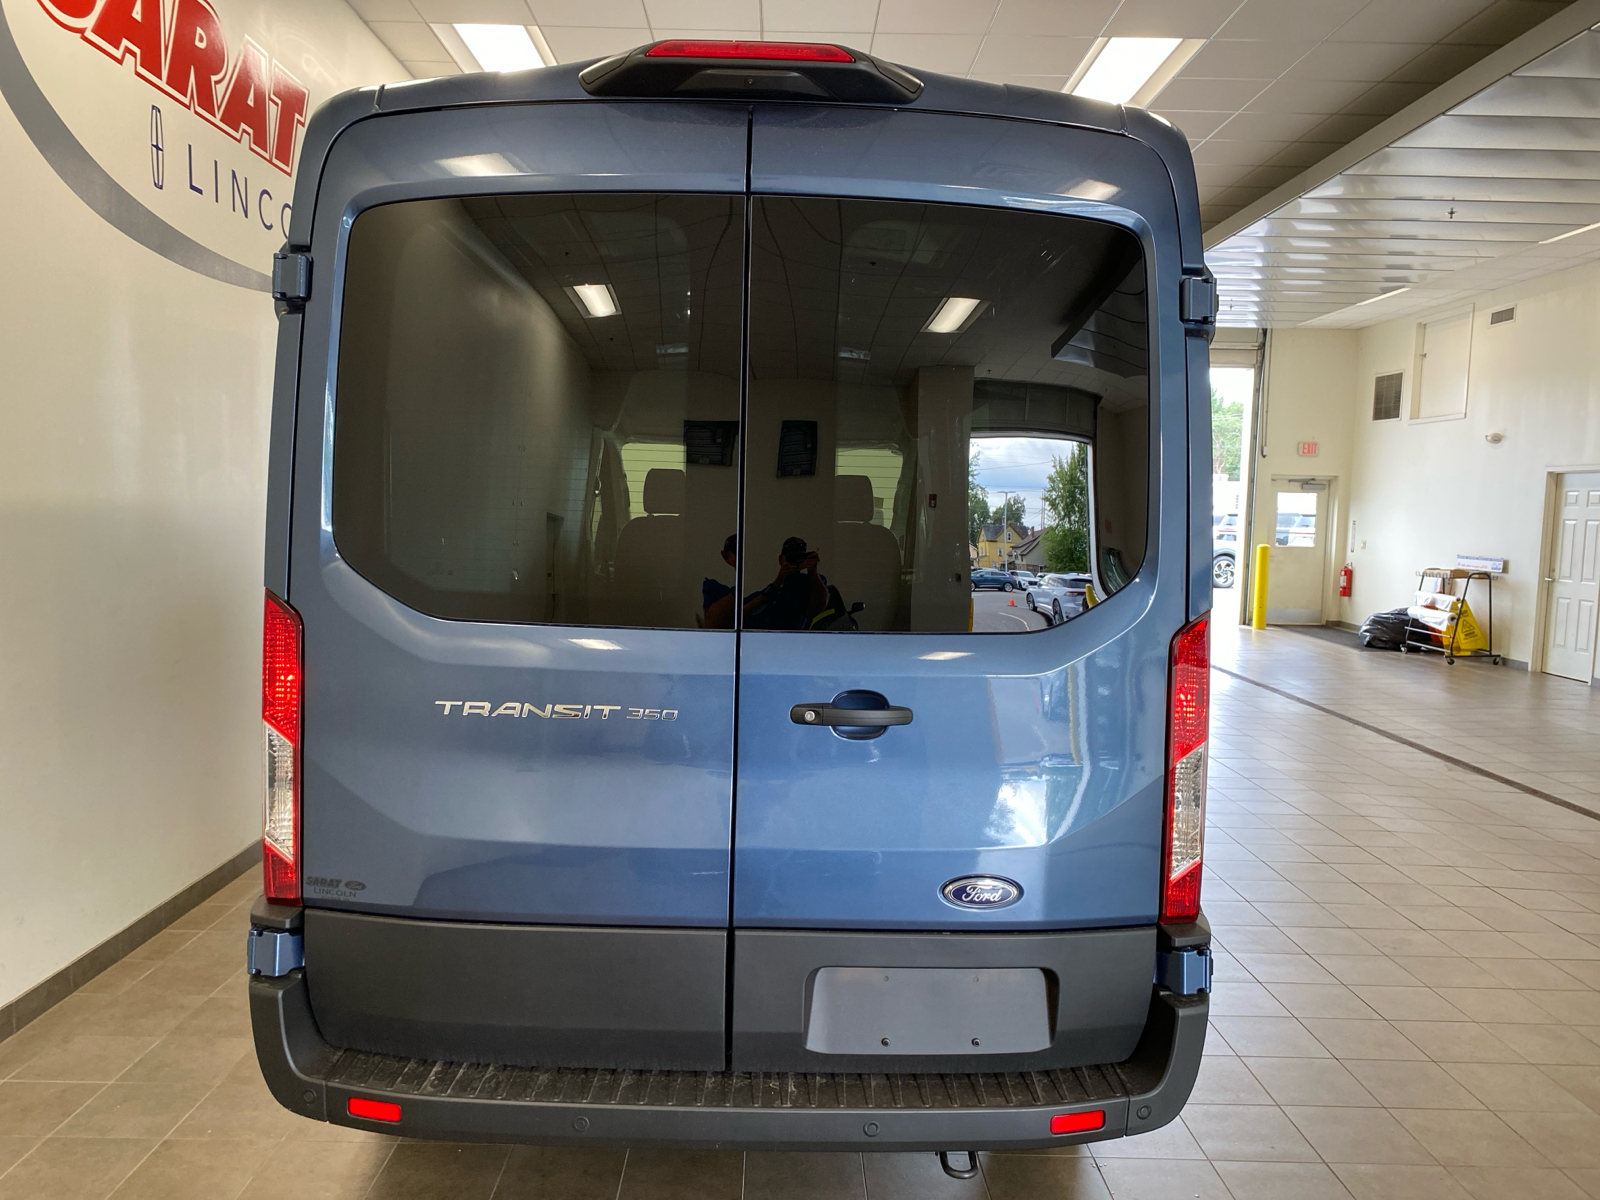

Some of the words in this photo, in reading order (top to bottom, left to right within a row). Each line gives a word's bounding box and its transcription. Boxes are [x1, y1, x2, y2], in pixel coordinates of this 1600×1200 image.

[1302, 442, 1318, 454] EXIT
[434, 700, 622, 720] TRANSIT
[626, 707, 679, 721] 350
[305, 876, 343, 888] SARAT
[313, 887, 356, 897] LINCOLN
[961, 884, 1003, 902] Ford
